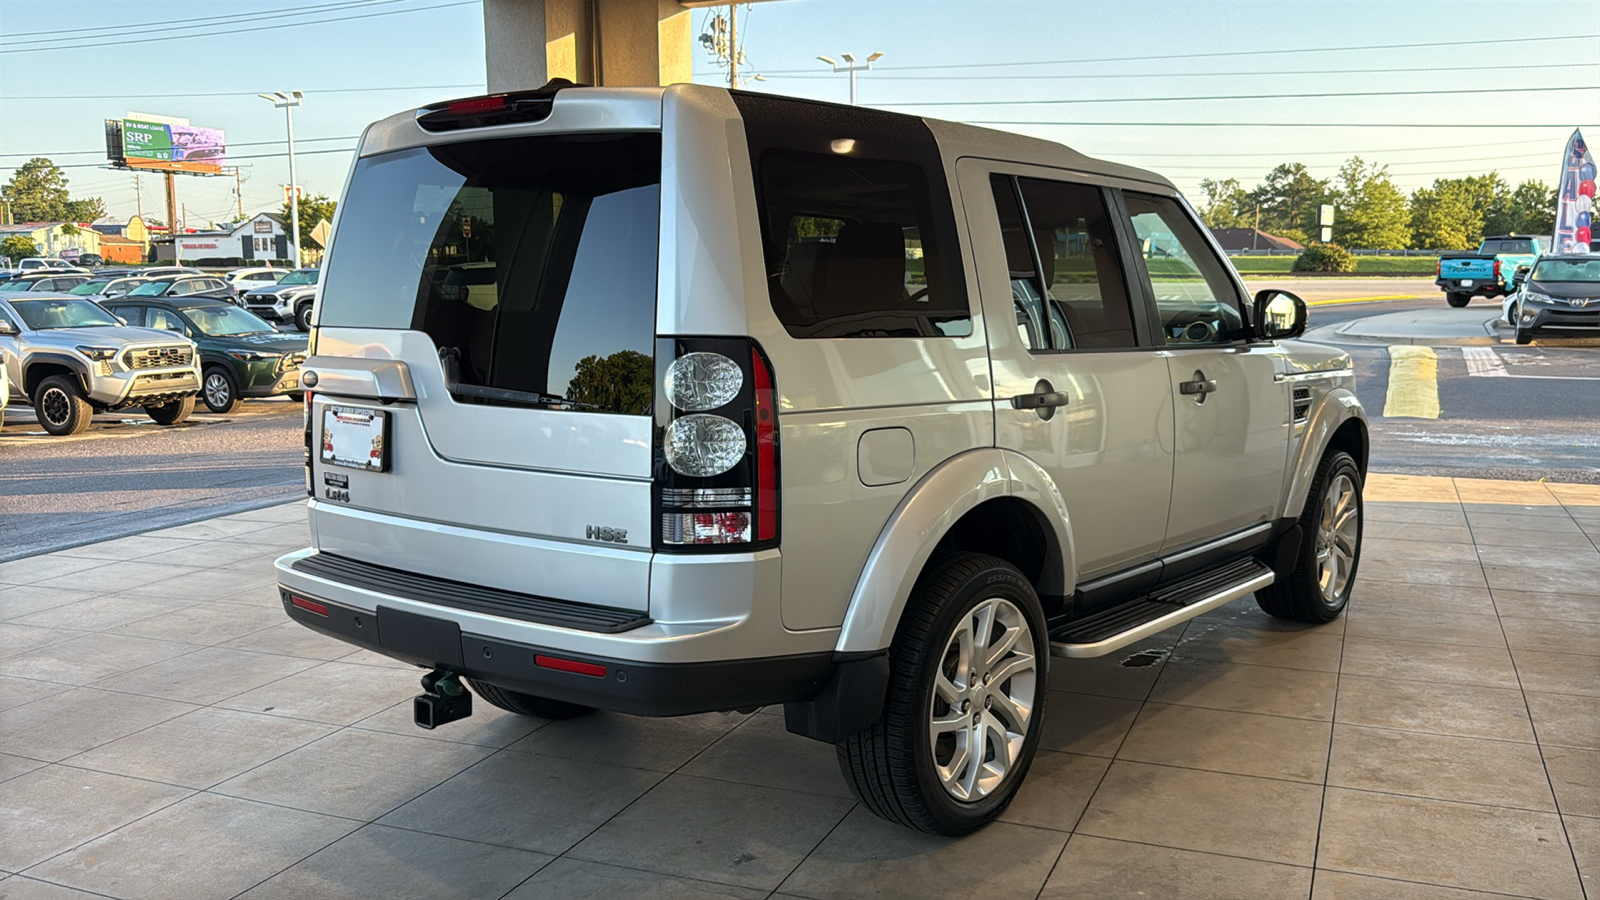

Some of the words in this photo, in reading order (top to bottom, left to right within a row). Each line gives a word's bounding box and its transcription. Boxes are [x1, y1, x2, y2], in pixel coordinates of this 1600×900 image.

[126, 131, 153, 143] SRP
[326, 487, 350, 502] LR4
[585, 524, 629, 544] HSE
